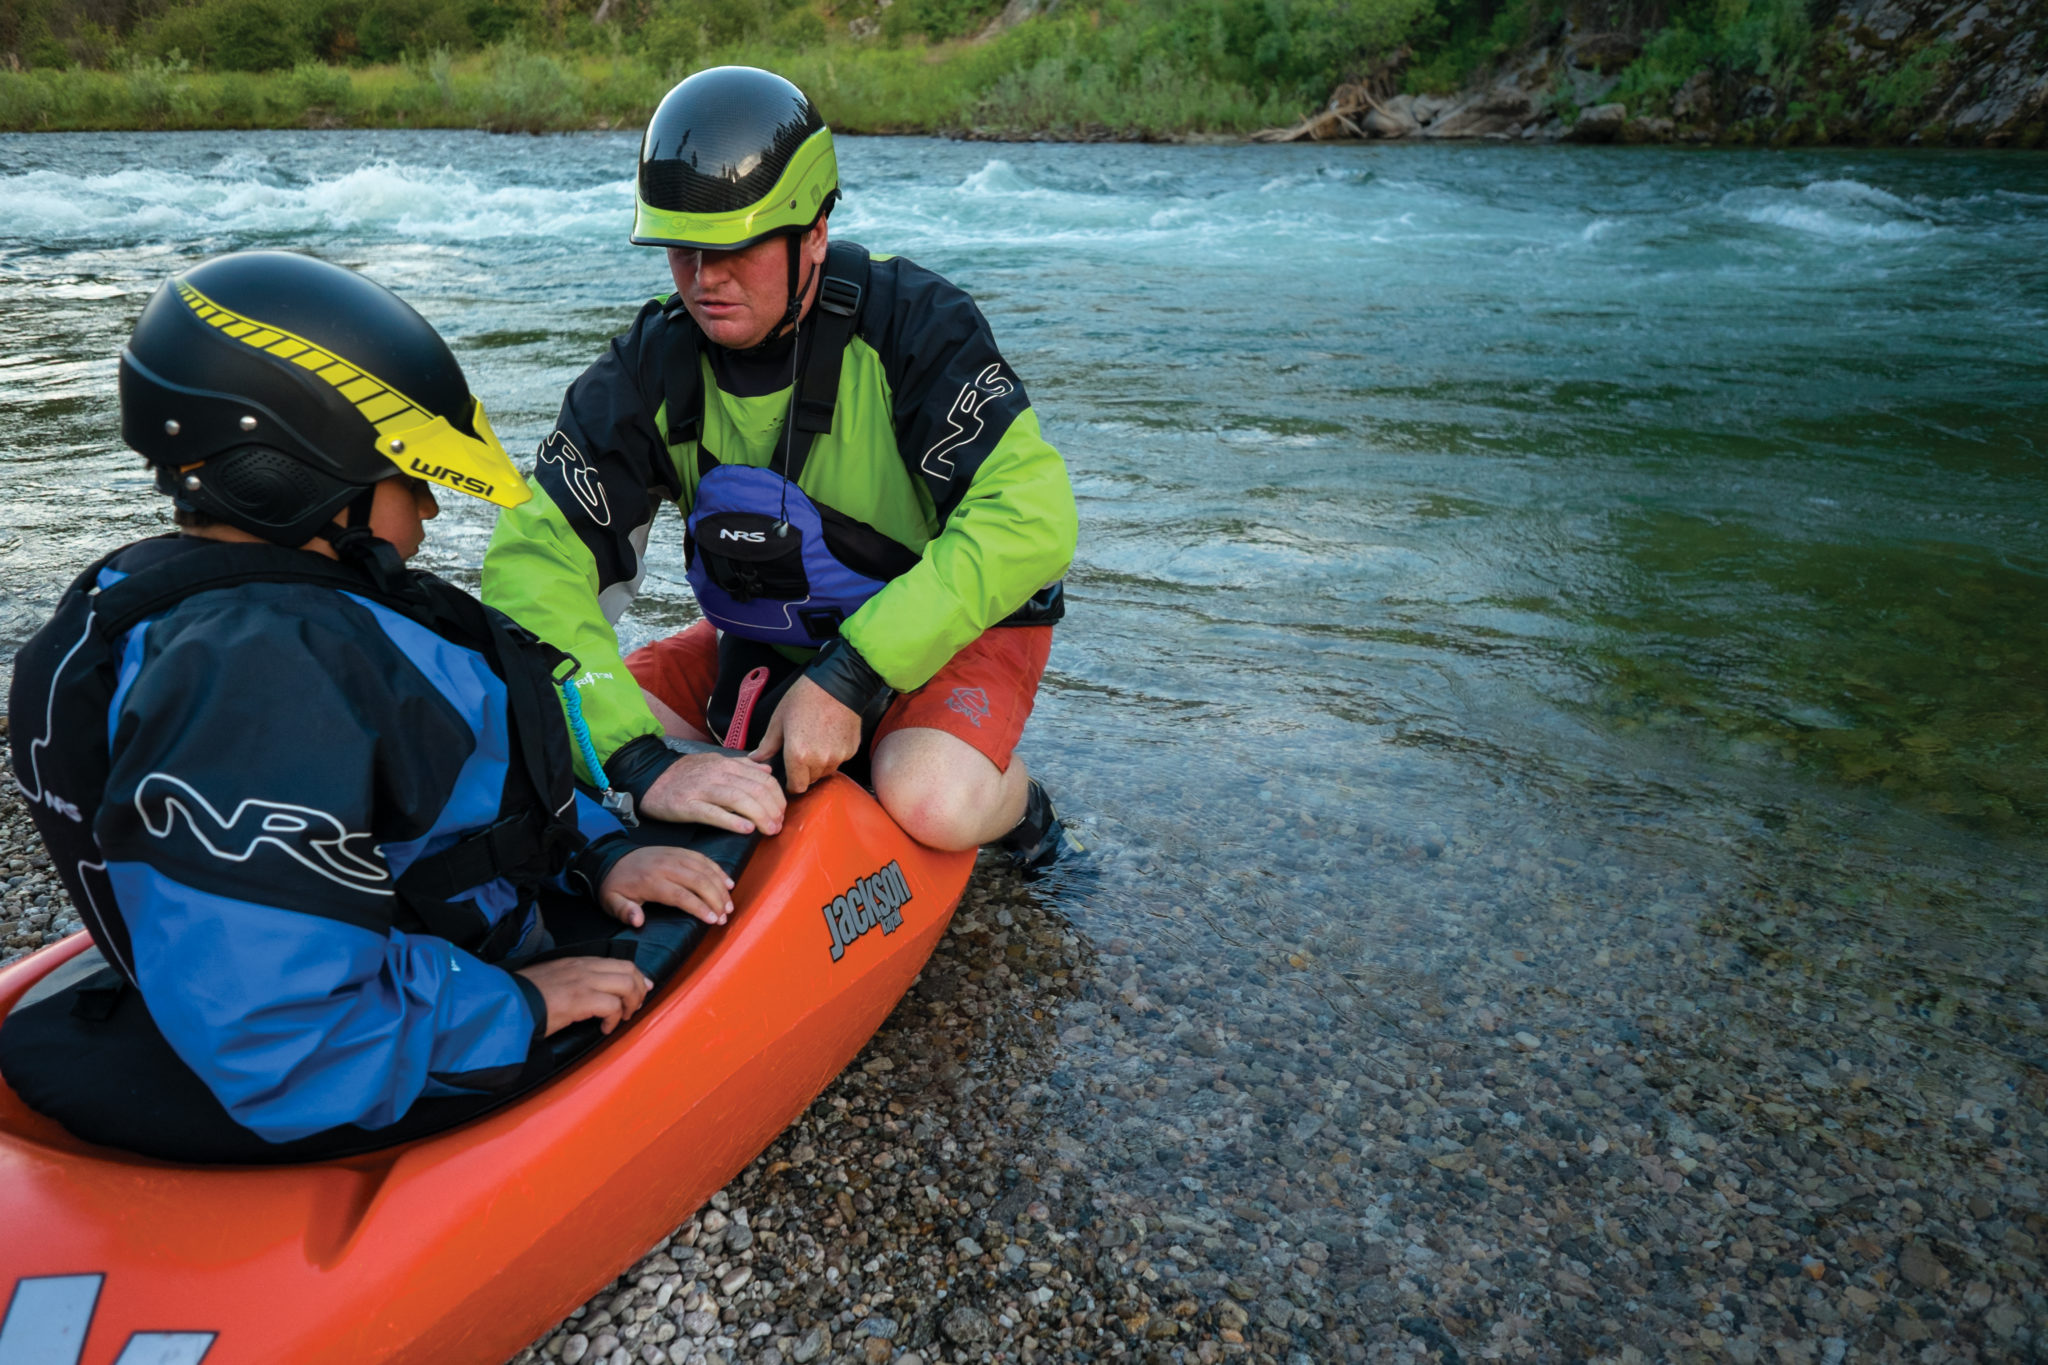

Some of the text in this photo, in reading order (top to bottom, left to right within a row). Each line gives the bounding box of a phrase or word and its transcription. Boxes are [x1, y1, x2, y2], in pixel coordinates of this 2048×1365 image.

[921, 363, 1014, 481] NRS
[409, 457, 495, 497] WRSI
[720, 528, 767, 543] NRS
[44, 789, 83, 823] NRS
